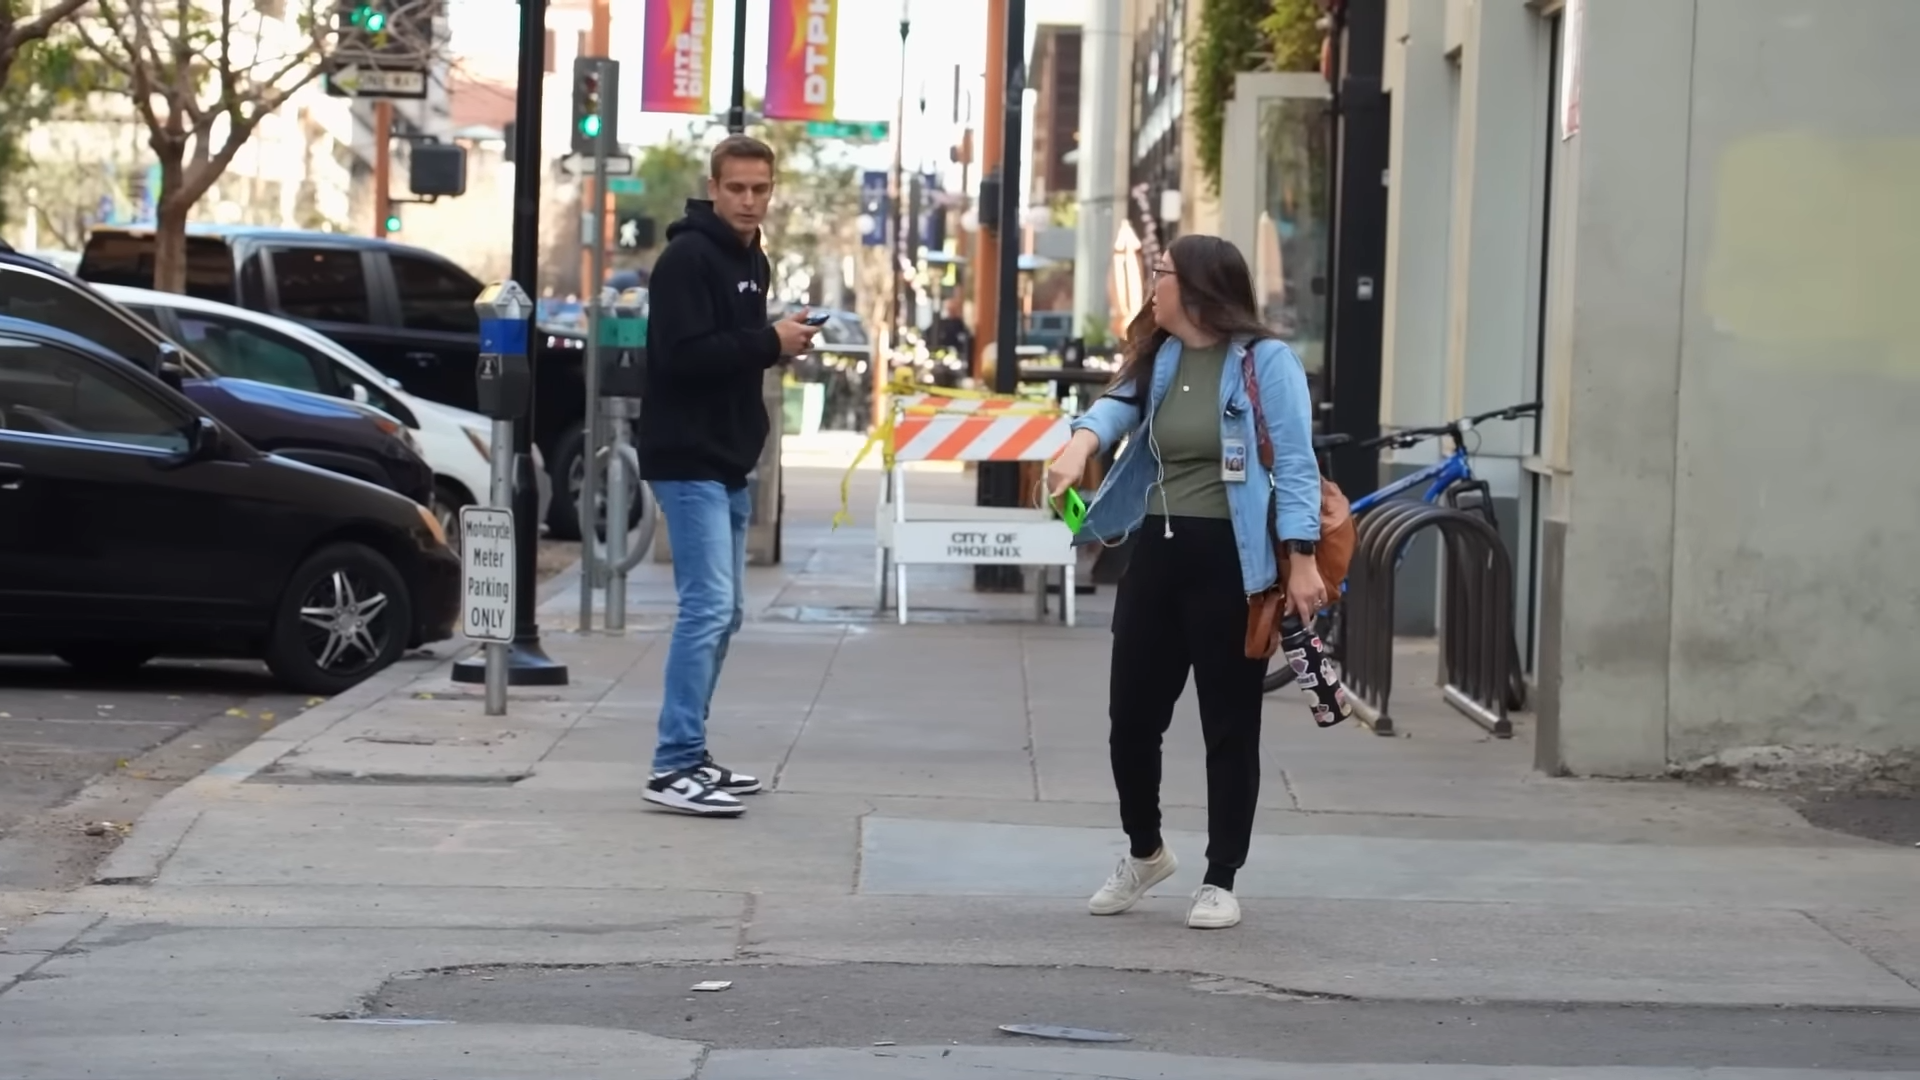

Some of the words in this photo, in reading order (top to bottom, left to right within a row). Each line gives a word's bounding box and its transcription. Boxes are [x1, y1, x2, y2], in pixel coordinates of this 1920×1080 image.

[673, 32, 690, 97] HITS
[466, 520, 510, 541] Motorcycle
[951, 532, 987, 544] CITY
[995, 532, 1018, 544] OF
[473, 547, 504, 568] Meter
[946, 546, 1022, 557] PHOENIX
[468, 576, 509, 604] Parking
[471, 606, 505, 629] ONLY
